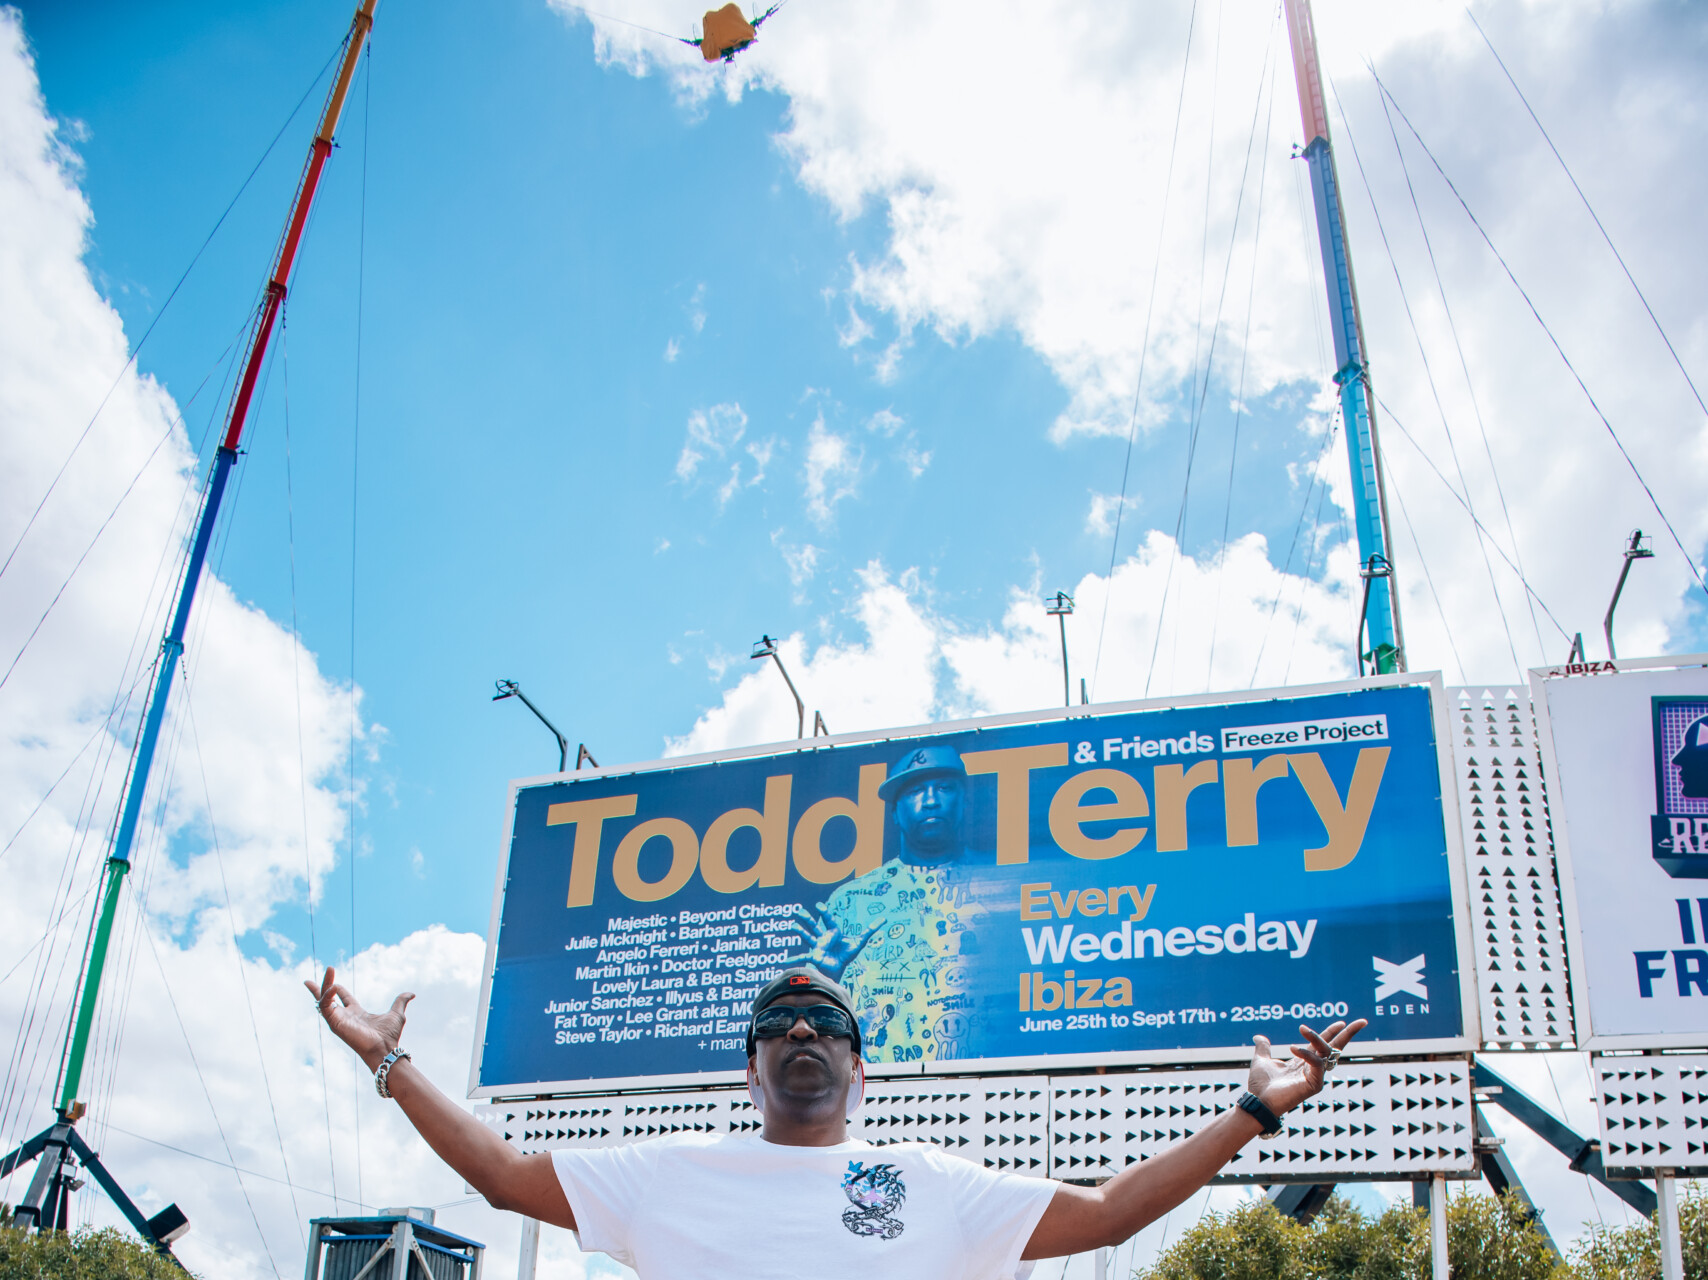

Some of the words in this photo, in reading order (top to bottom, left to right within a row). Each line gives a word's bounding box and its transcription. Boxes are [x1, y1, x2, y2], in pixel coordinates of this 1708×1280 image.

[1565, 661, 1616, 674] IBIZA
[1074, 741, 1097, 764] &
[1103, 730, 1215, 761] Friends
[1224, 730, 1299, 748] Freeze
[1304, 720, 1384, 742] Project
[546, 762, 888, 909] Todd
[960, 742, 1392, 872] Terry
[1020, 882, 1157, 922] Every
[607, 914, 668, 932] Majestic
[679, 906, 737, 925] Beyond
[738, 903, 803, 919] Chicago
[565, 936, 598, 951] Julie
[600, 929, 667, 946] Mcknight
[678, 925, 739, 941] Barbara
[742, 918, 796, 934] Tucker
[596, 946, 648, 964] Angelo
[650, 941, 700, 958] Ferreri
[710, 937, 761, 953] Janika
[764, 934, 802, 948] Tenn
[1021, 912, 1318, 966] Wednesday
[575, 964, 621, 980] Martin
[623, 962, 650, 976] Ikin
[661, 957, 713, 973] Doctor
[715, 949, 788, 968] Feelgood
[592, 978, 640, 995] Lovely
[641, 976, 684, 990] Laura
[686, 973, 698, 987] &
[701, 971, 732, 986] Ben
[1019, 970, 1134, 1012] Ibiza
[544, 998, 589, 1014] Junior
[590, 994, 654, 1010] Sanchez
[665, 990, 704, 1006] Illyus
[706, 987, 718, 1001] &
[1375, 1003, 1430, 1016] EDEN
[555, 1014, 577, 1029] Fat
[580, 1013, 615, 1028] Tony
[625, 1010, 653, 1024] Lee
[655, 1006, 699, 1022] Grant
[701, 1003, 729, 1018] aka
[1019, 1017, 1063, 1032] June
[1066, 1013, 1107, 1030] 25th
[1110, 1013, 1129, 1027] to
[1132, 1010, 1175, 1028] Sept
[1178, 1007, 1217, 1024] 17th
[1230, 1001, 1349, 1022] 23:59-06:00
[555, 1030, 596, 1045] Steve
[599, 1027, 643, 1044] Taylor
[654, 1021, 713, 1039] Richard
[710, 1038, 747, 1052] many
[892, 1044, 923, 1063] RAD
